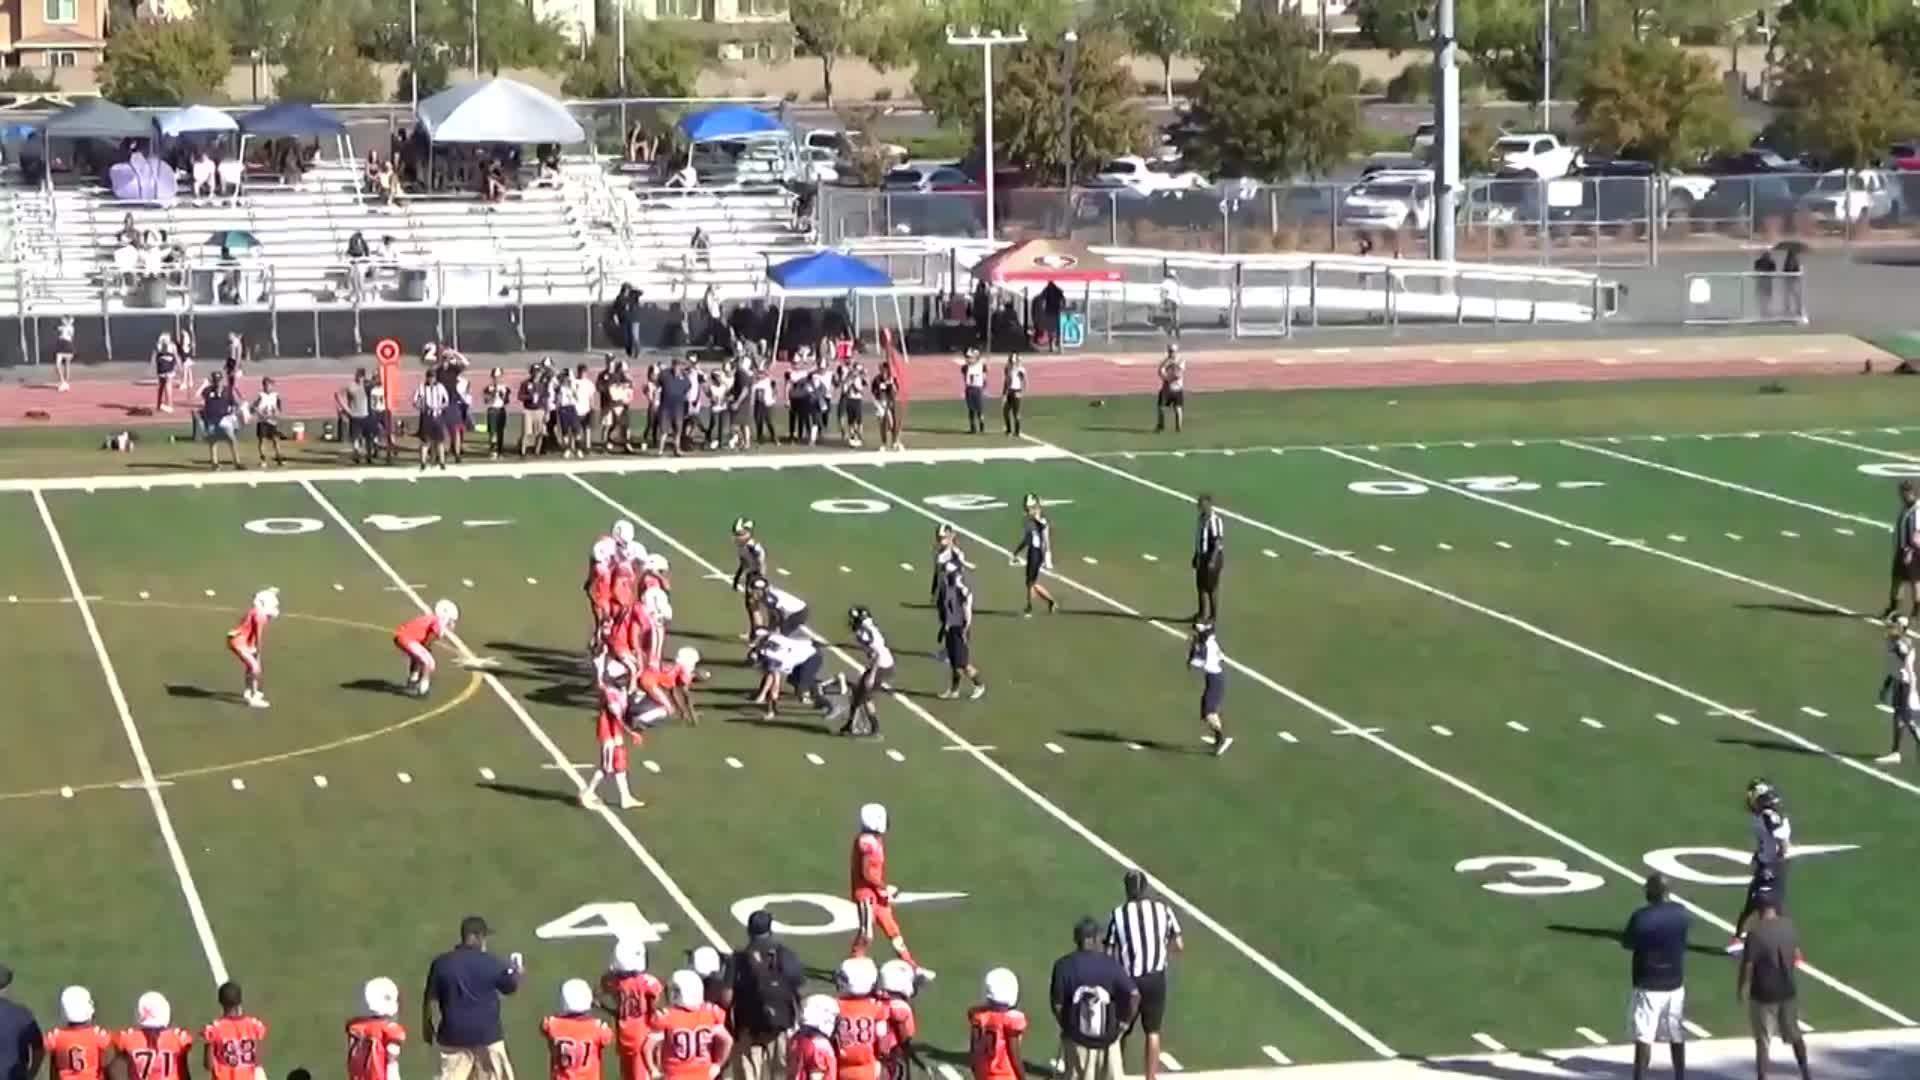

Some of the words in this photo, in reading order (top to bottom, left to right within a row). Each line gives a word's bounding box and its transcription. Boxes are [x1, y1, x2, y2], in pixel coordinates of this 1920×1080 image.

[424, 341, 438, 361] 2
[68, 1045, 86, 1073] 6
[133, 1048, 173, 1080] 71
